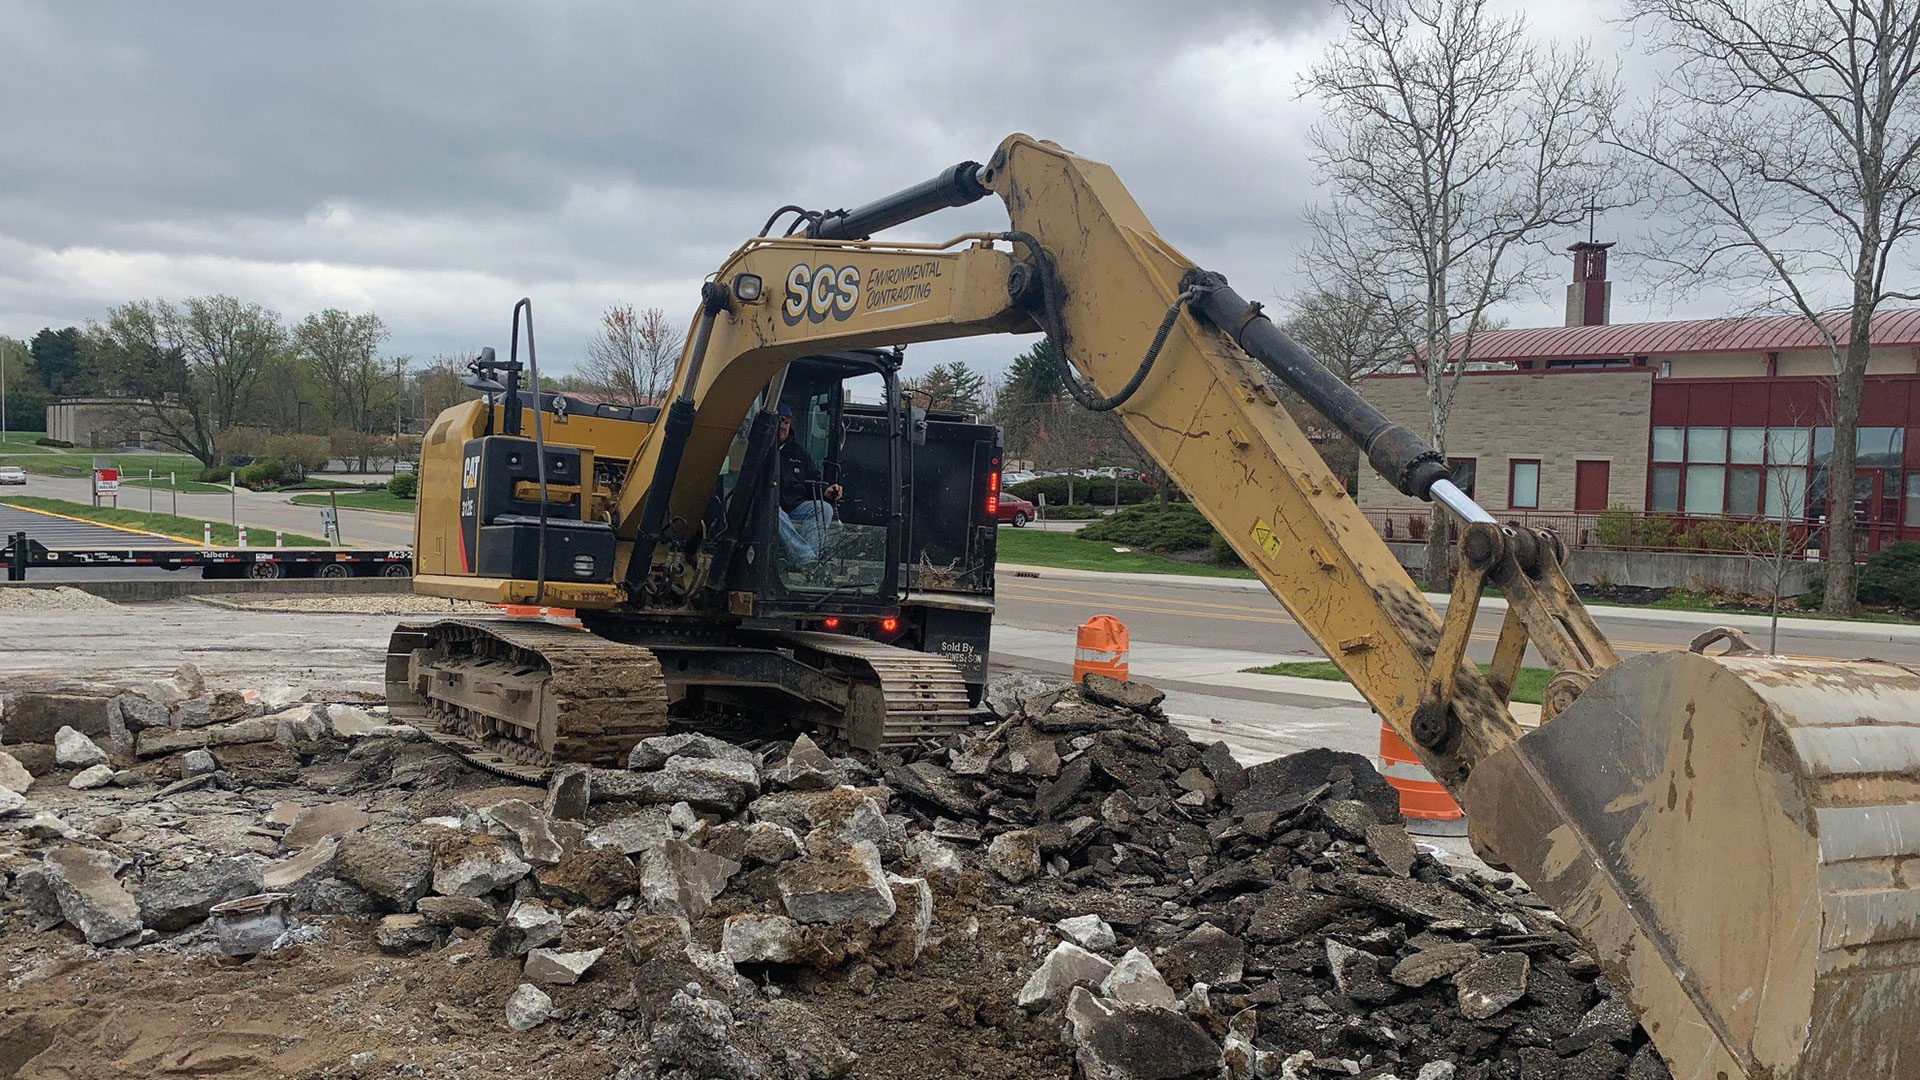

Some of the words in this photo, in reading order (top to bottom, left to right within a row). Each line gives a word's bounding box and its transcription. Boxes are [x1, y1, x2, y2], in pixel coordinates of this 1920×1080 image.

[866, 261, 942, 292] ENVIRONMENTAL
[782, 263, 860, 326] SCS
[867, 282, 931, 309] CONTRACTING
[463, 456, 480, 489] CAT
[201, 551, 229, 559] Talbert
[941, 641, 960, 651] Sold
[962, 643, 974, 655] By
